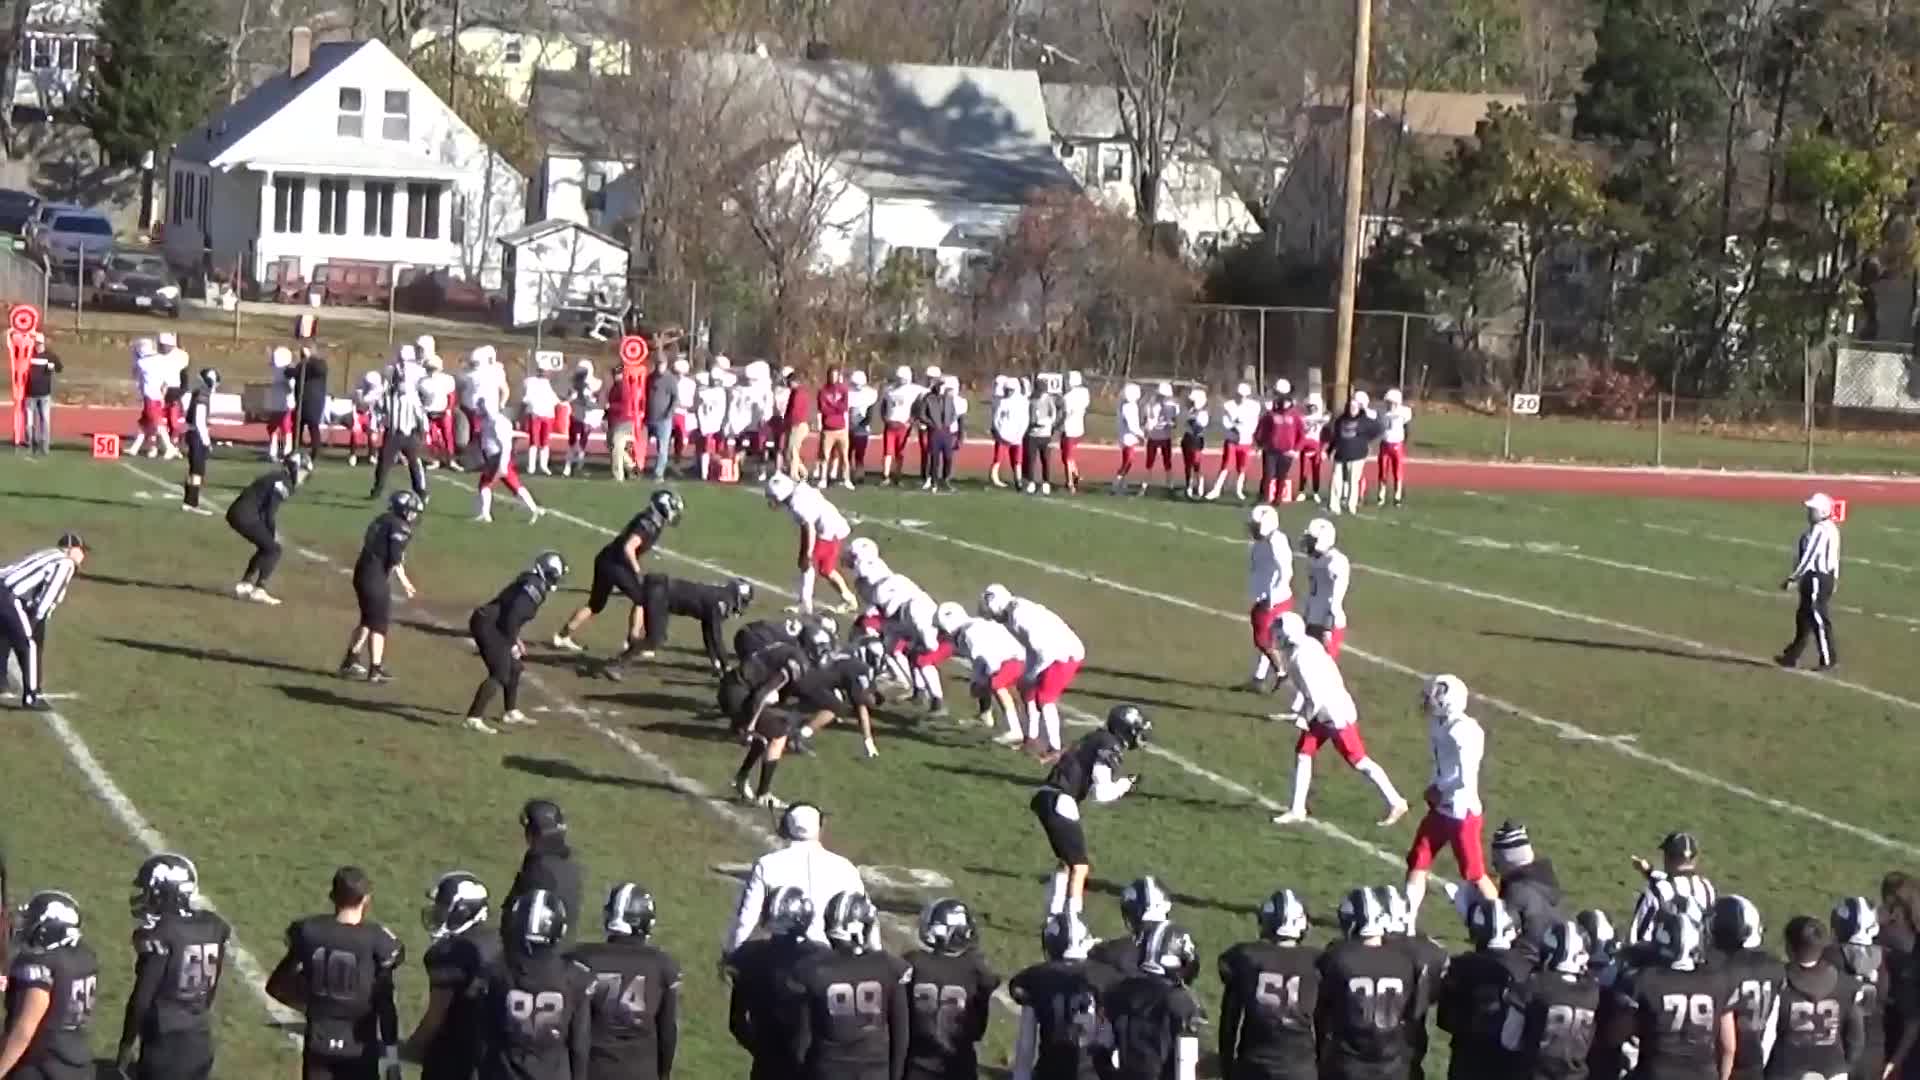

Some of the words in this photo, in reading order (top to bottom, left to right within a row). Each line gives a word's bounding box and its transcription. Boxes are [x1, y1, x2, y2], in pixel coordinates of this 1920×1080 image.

[1517, 398, 1537, 410] 20
[97, 438, 115, 455] 50
[311, 946, 357, 1000] 10
[596, 972, 646, 1026] 74
[1663, 993, 1714, 1035] 79
